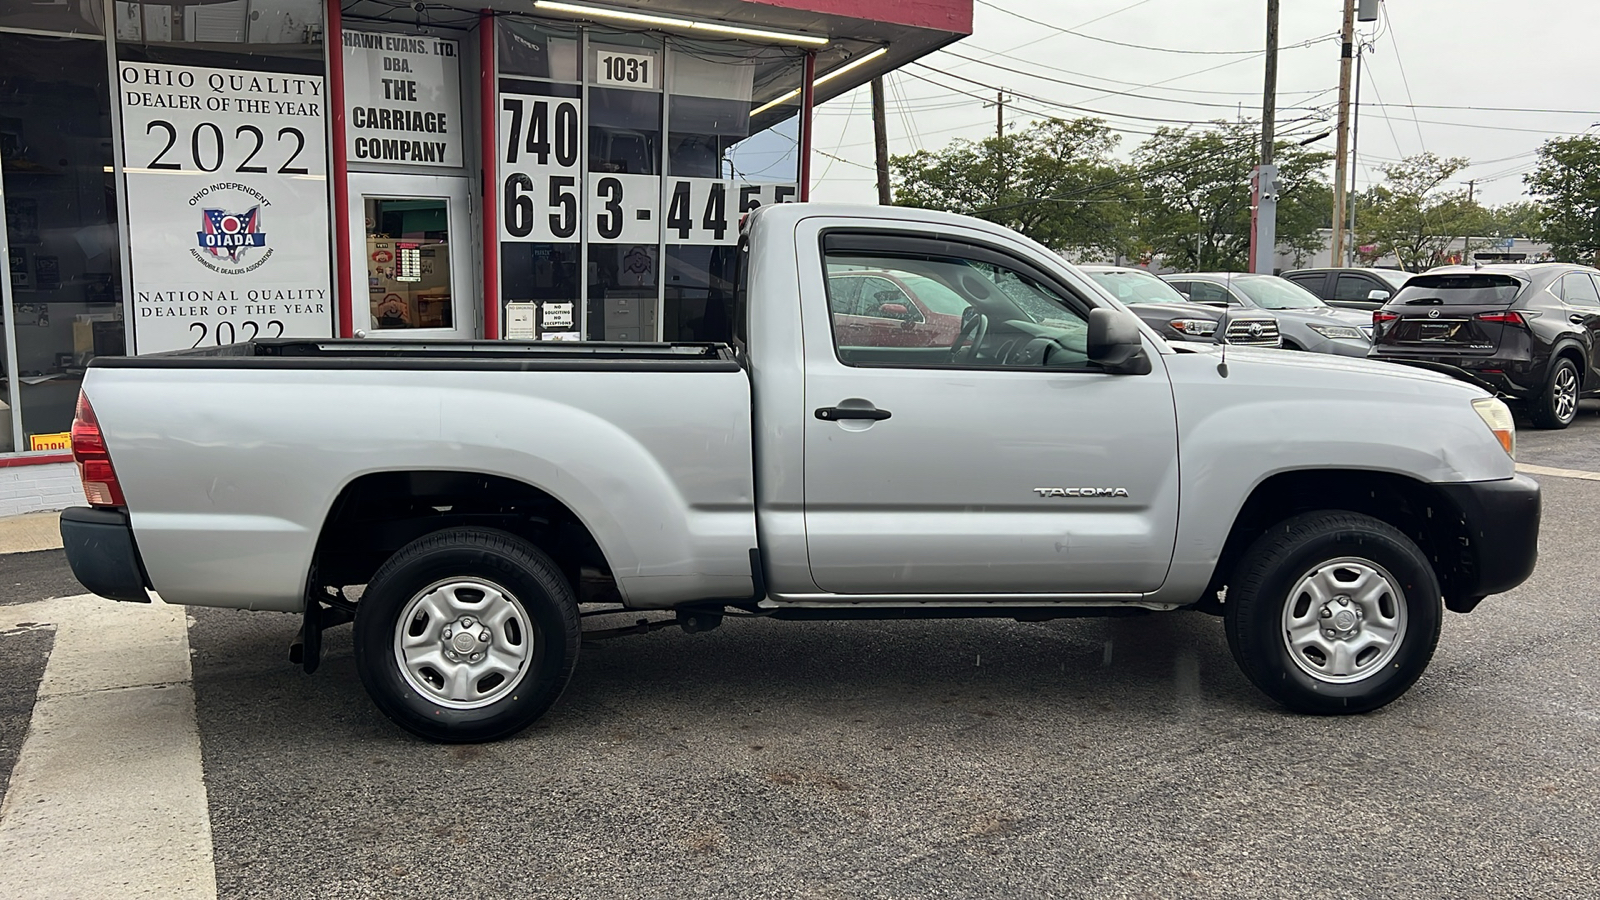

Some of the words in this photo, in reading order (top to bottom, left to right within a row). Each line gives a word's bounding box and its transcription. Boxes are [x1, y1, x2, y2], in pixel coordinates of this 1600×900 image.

[343, 32, 382, 50] HAWN
[386, 36, 428, 54] EVANS.
[433, 41, 457, 57] LTD.
[383, 56, 413, 73] DBA.
[603, 56, 648, 83] 1031
[122, 67, 194, 88] OHIO
[208, 73, 322, 96] QUALITY
[381, 78, 417, 102] THE
[126, 91, 202, 110] DEALER
[206, 97, 230, 112] OF
[235, 98, 270, 114] THE
[275, 101, 320, 117] YEAR
[352, 106, 447, 134] CARRIAGE
[502, 98, 578, 168] 740
[146, 119, 309, 175] 2022
[355, 137, 447, 163] COMPANY
[188, 187, 209, 206] OHIO
[210, 182, 272, 208] INDEPENDENT
[205, 233, 255, 246] OIADA
[189, 247, 220, 273] AUTOMOBILE
[220, 267, 246, 275] DEALERS
[246, 247, 274, 273] ASSOCIATION
[138, 289, 239, 303] NATIONAL
[247, 288, 326, 303] QUALITY
[141, 304, 209, 318] DEALER
[217, 305, 238, 316] OF
[245, 304, 277, 315] THE
[283, 303, 325, 315] YEAR
[189, 320, 284, 349] 2022
[1033, 487, 1129, 498] TACOMA
